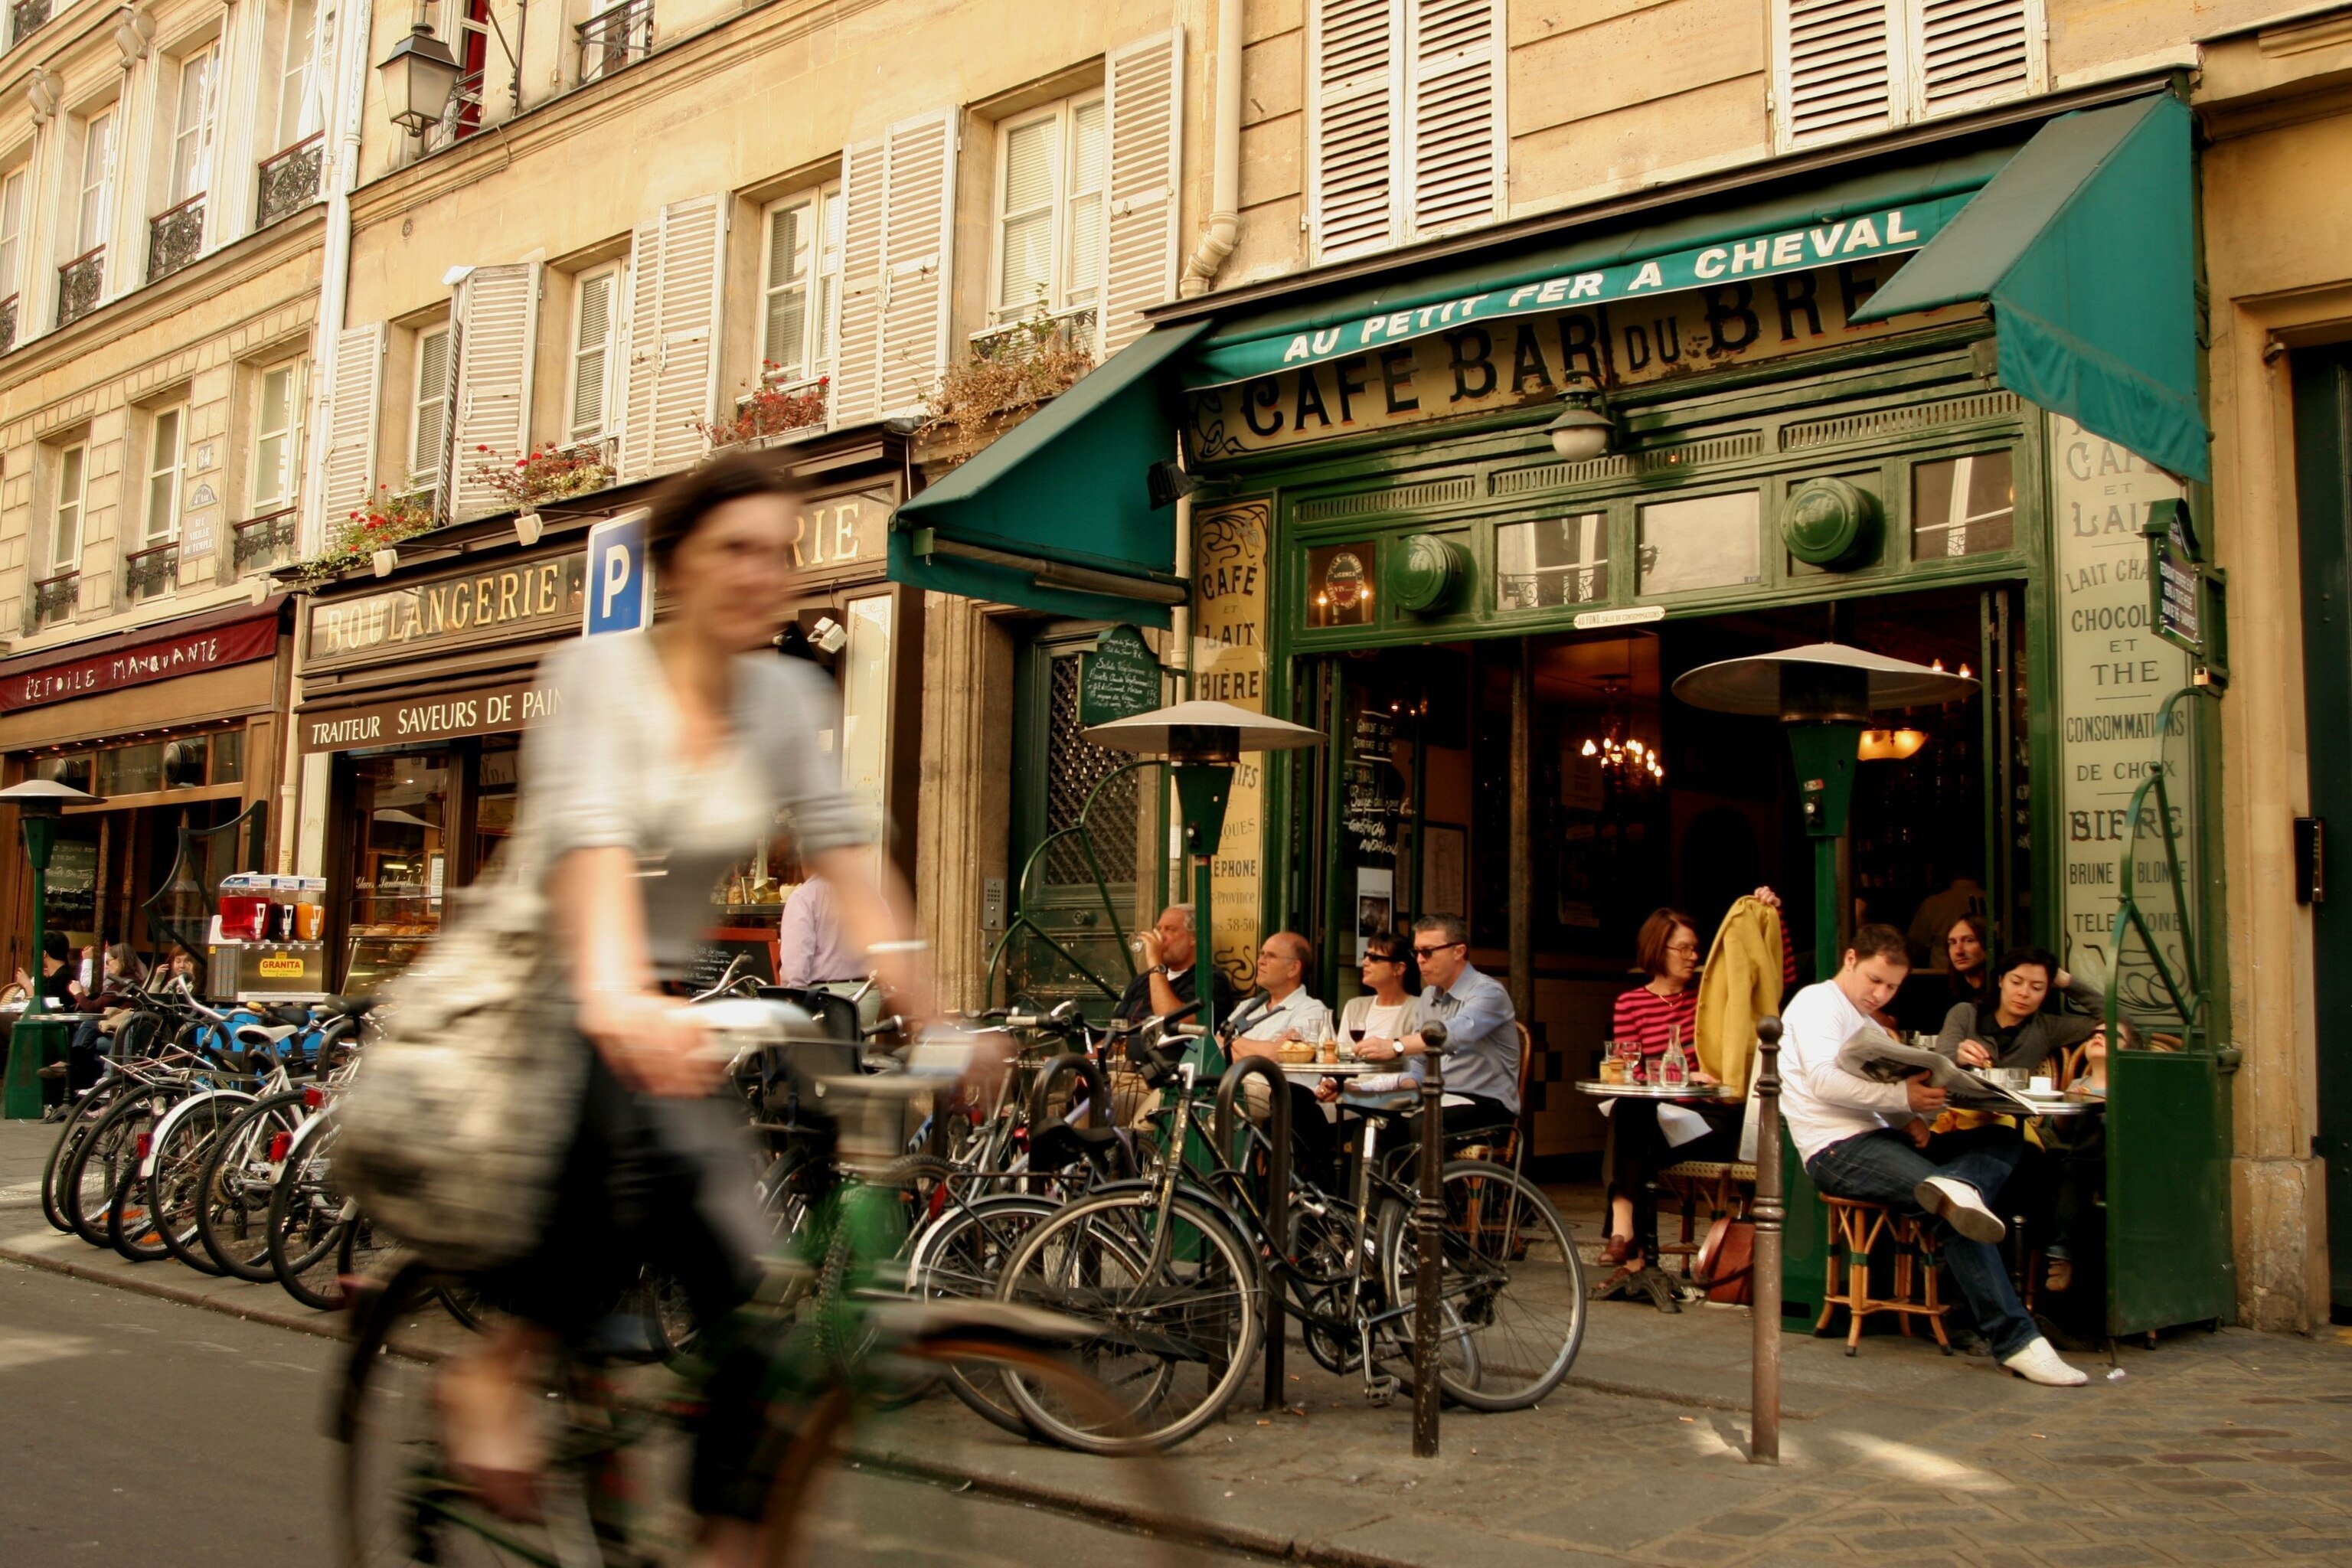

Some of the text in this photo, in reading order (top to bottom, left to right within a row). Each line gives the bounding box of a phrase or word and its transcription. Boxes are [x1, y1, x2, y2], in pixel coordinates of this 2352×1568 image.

[1284, 211, 1917, 363] AU PETIT FER A CHEVAL
[1443, 313, 1602, 403] BAR
[1624, 315, 1681, 372] DU
[198, 446, 212, 468] 34
[2104, 483, 2132, 495] ET
[2071, 501, 2151, 537] LAI
[602, 544, 631, 619] P
[1202, 563, 1258, 600] CAFÉ
[2066, 562, 2108, 594] LAIT
[2115, 559, 2150, 582] CHA
[325, 564, 559, 652] BOULANGERIE
[2071, 604, 2151, 632] CHOCOL
[1204, 622, 1256, 649] LAIT
[2110, 639, 2138, 652] ET
[113, 638, 217, 679] MANQUANTE
[1200, 668, 1259, 701] BIÈRE
[312, 716, 381, 746] TRAITEUR
[397, 700, 477, 735] SAVEURS
[487, 694, 512, 724] DE
[2066, 710, 2185, 743] CONSOMMATINS
[2076, 760, 2177, 782] DE CHOX
[2069, 861, 2188, 884] BRUNE BLONE
[2073, 911, 2182, 933] TELEONE
